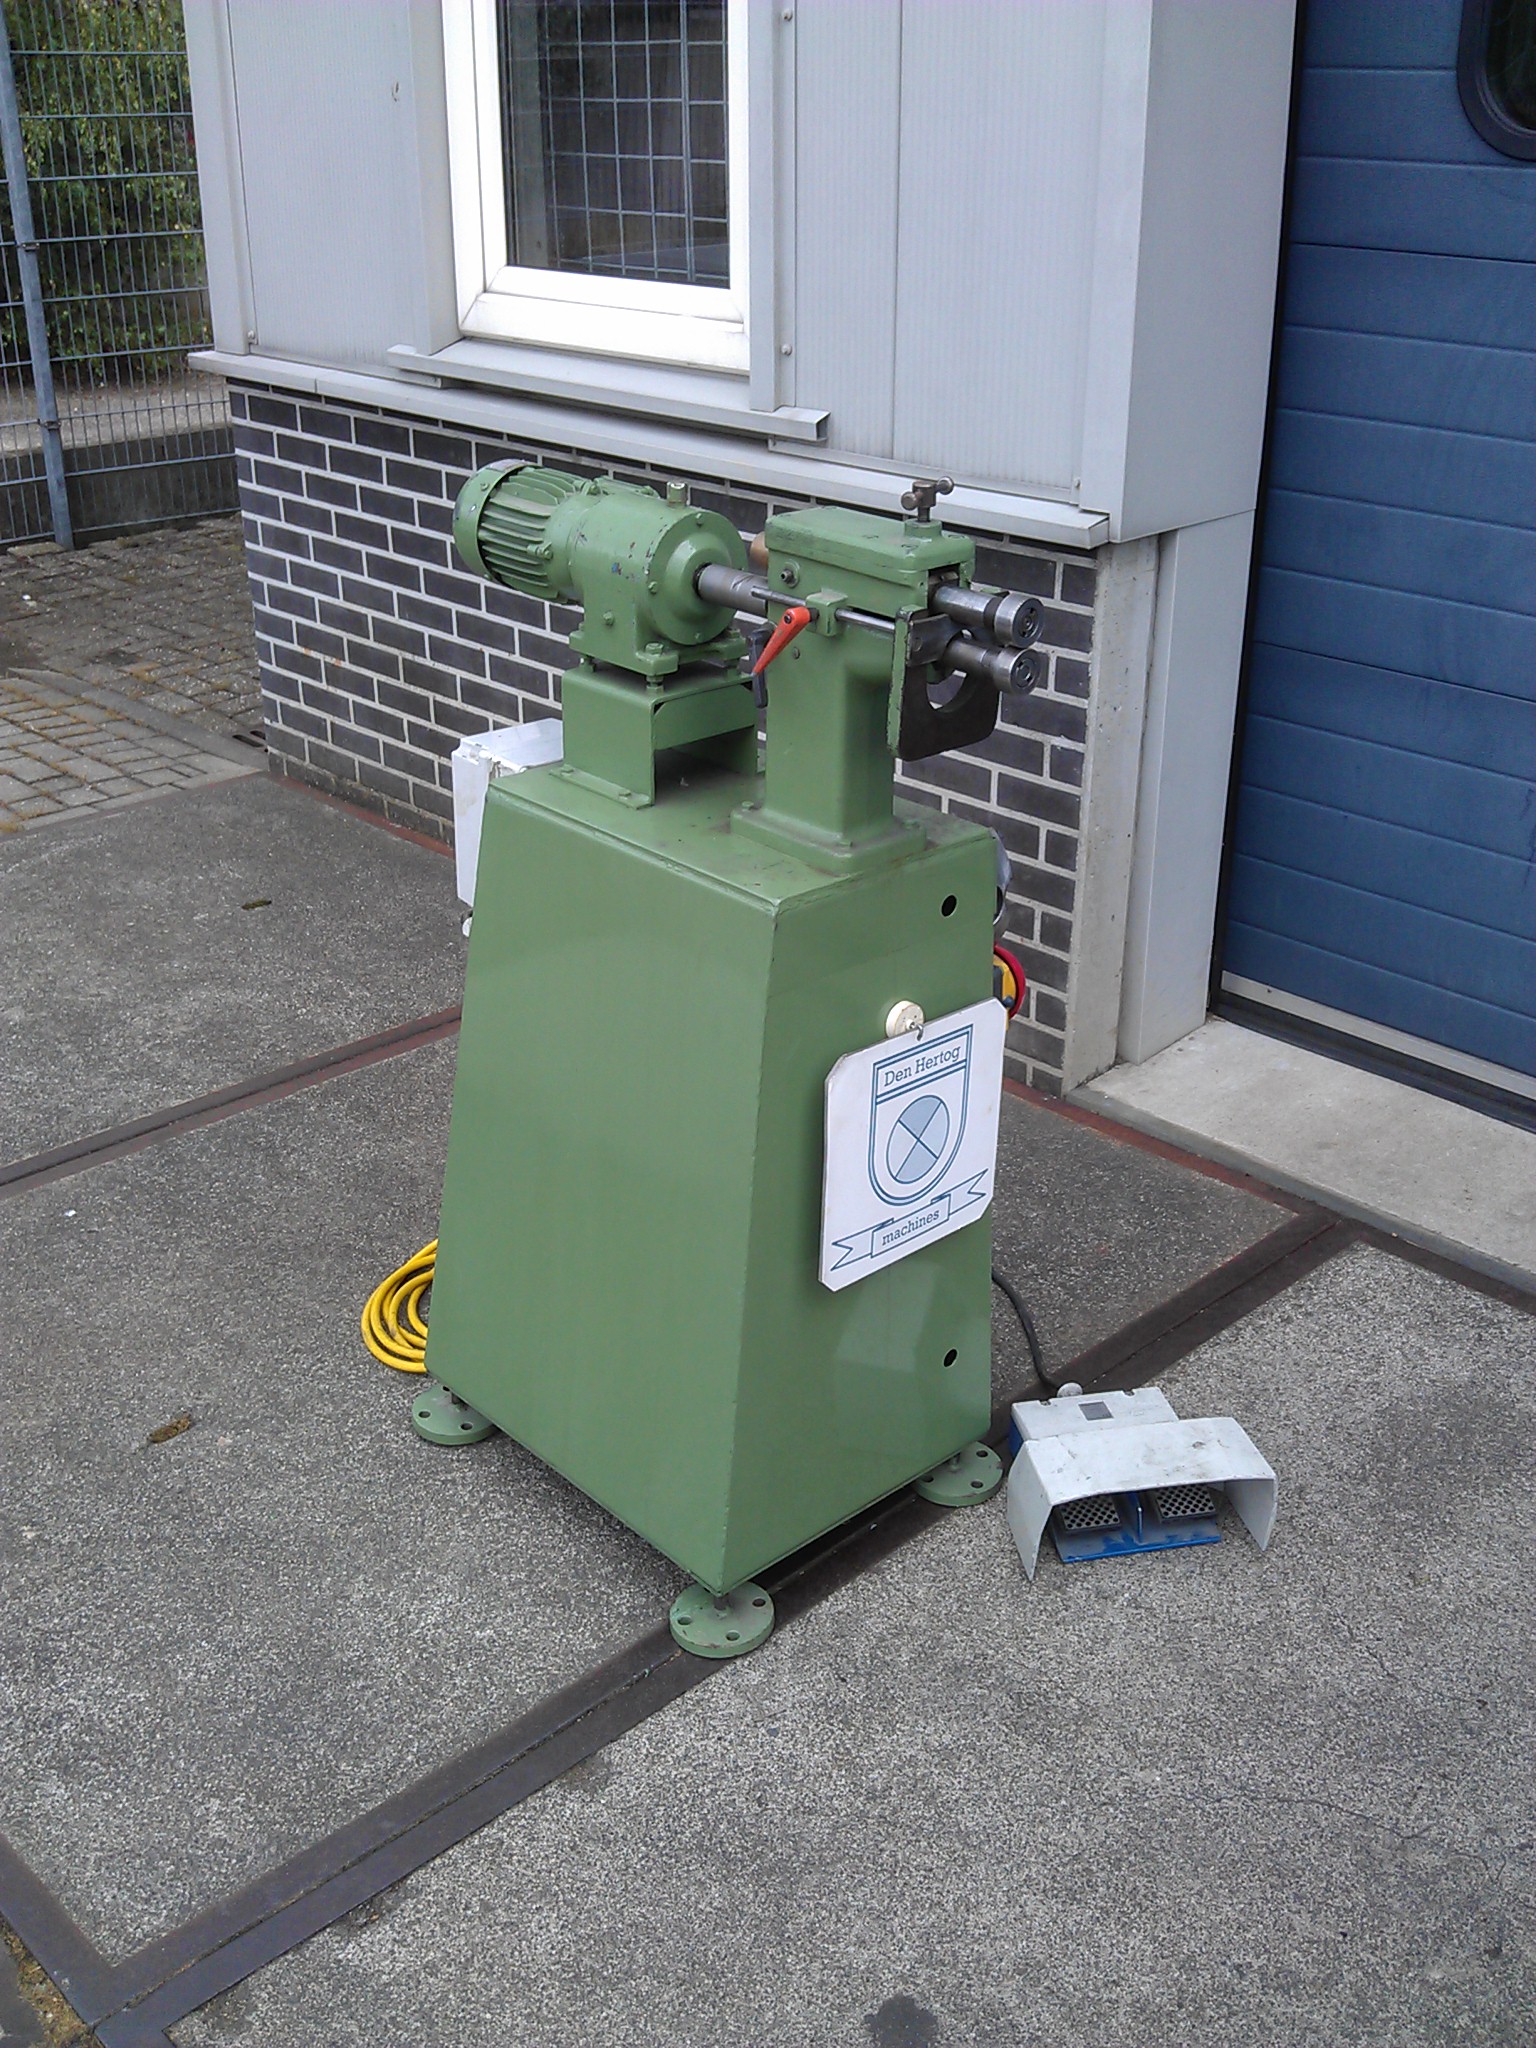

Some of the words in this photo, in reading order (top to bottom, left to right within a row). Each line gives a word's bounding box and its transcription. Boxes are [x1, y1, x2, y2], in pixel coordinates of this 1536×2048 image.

[884, 1065, 912, 1087] Den
[914, 1045, 961, 1075] Hertog
[882, 1209, 940, 1246] machines
